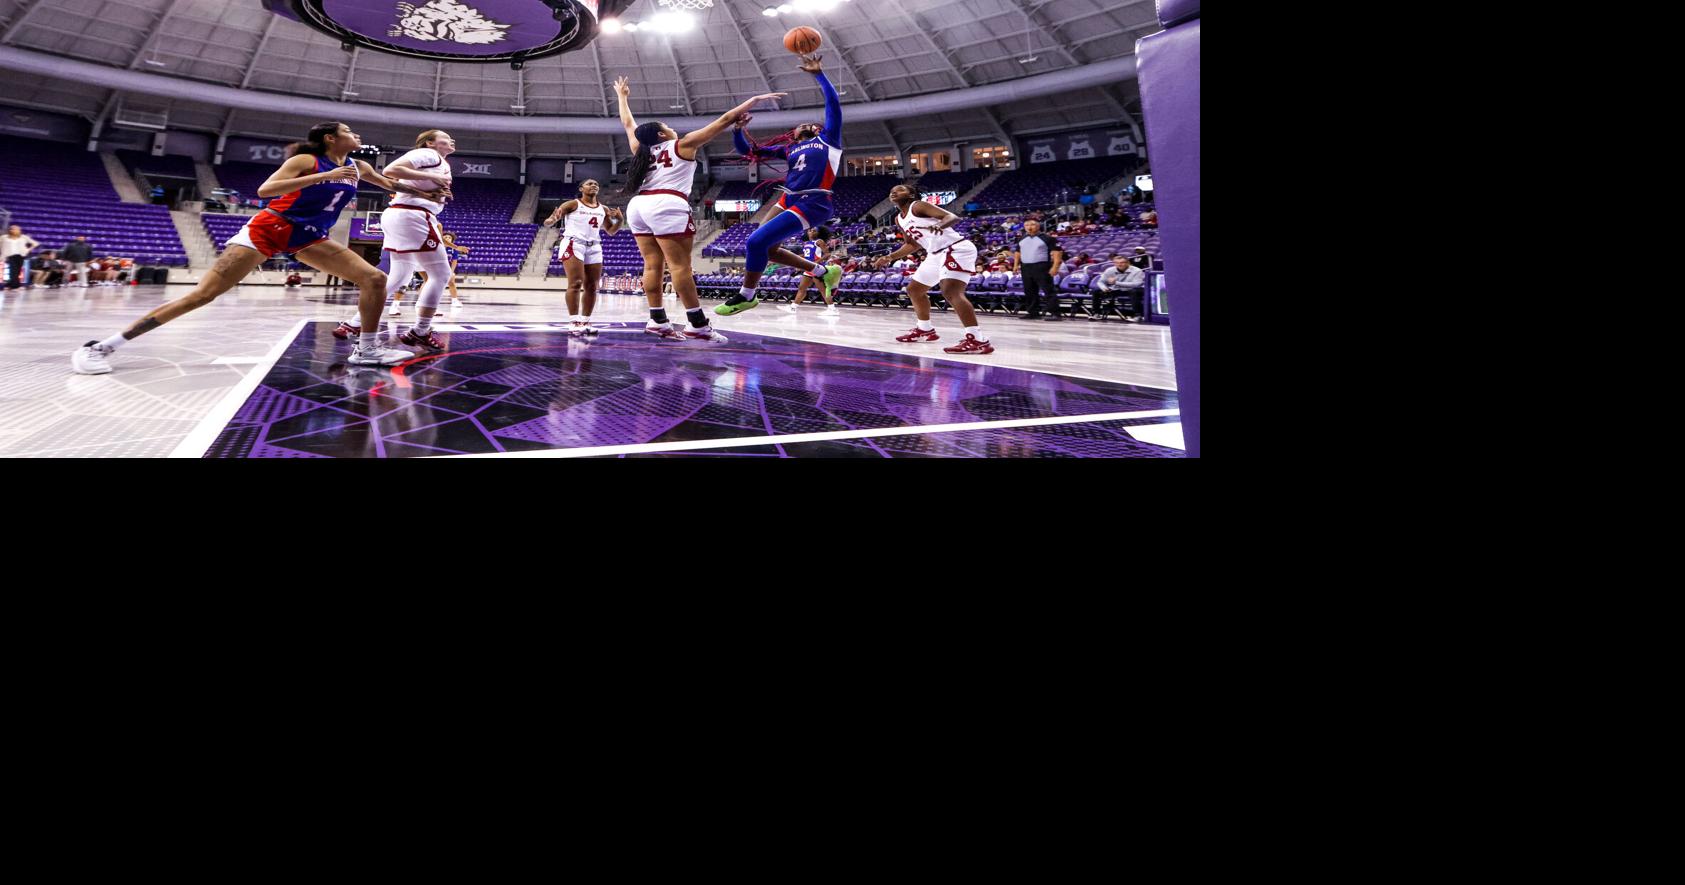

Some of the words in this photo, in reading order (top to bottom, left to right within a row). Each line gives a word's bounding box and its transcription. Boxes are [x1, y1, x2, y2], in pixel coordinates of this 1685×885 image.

[792, 153, 807, 171] 4
[322, 190, 345, 212] 1
[588, 217, 598, 229] 4
